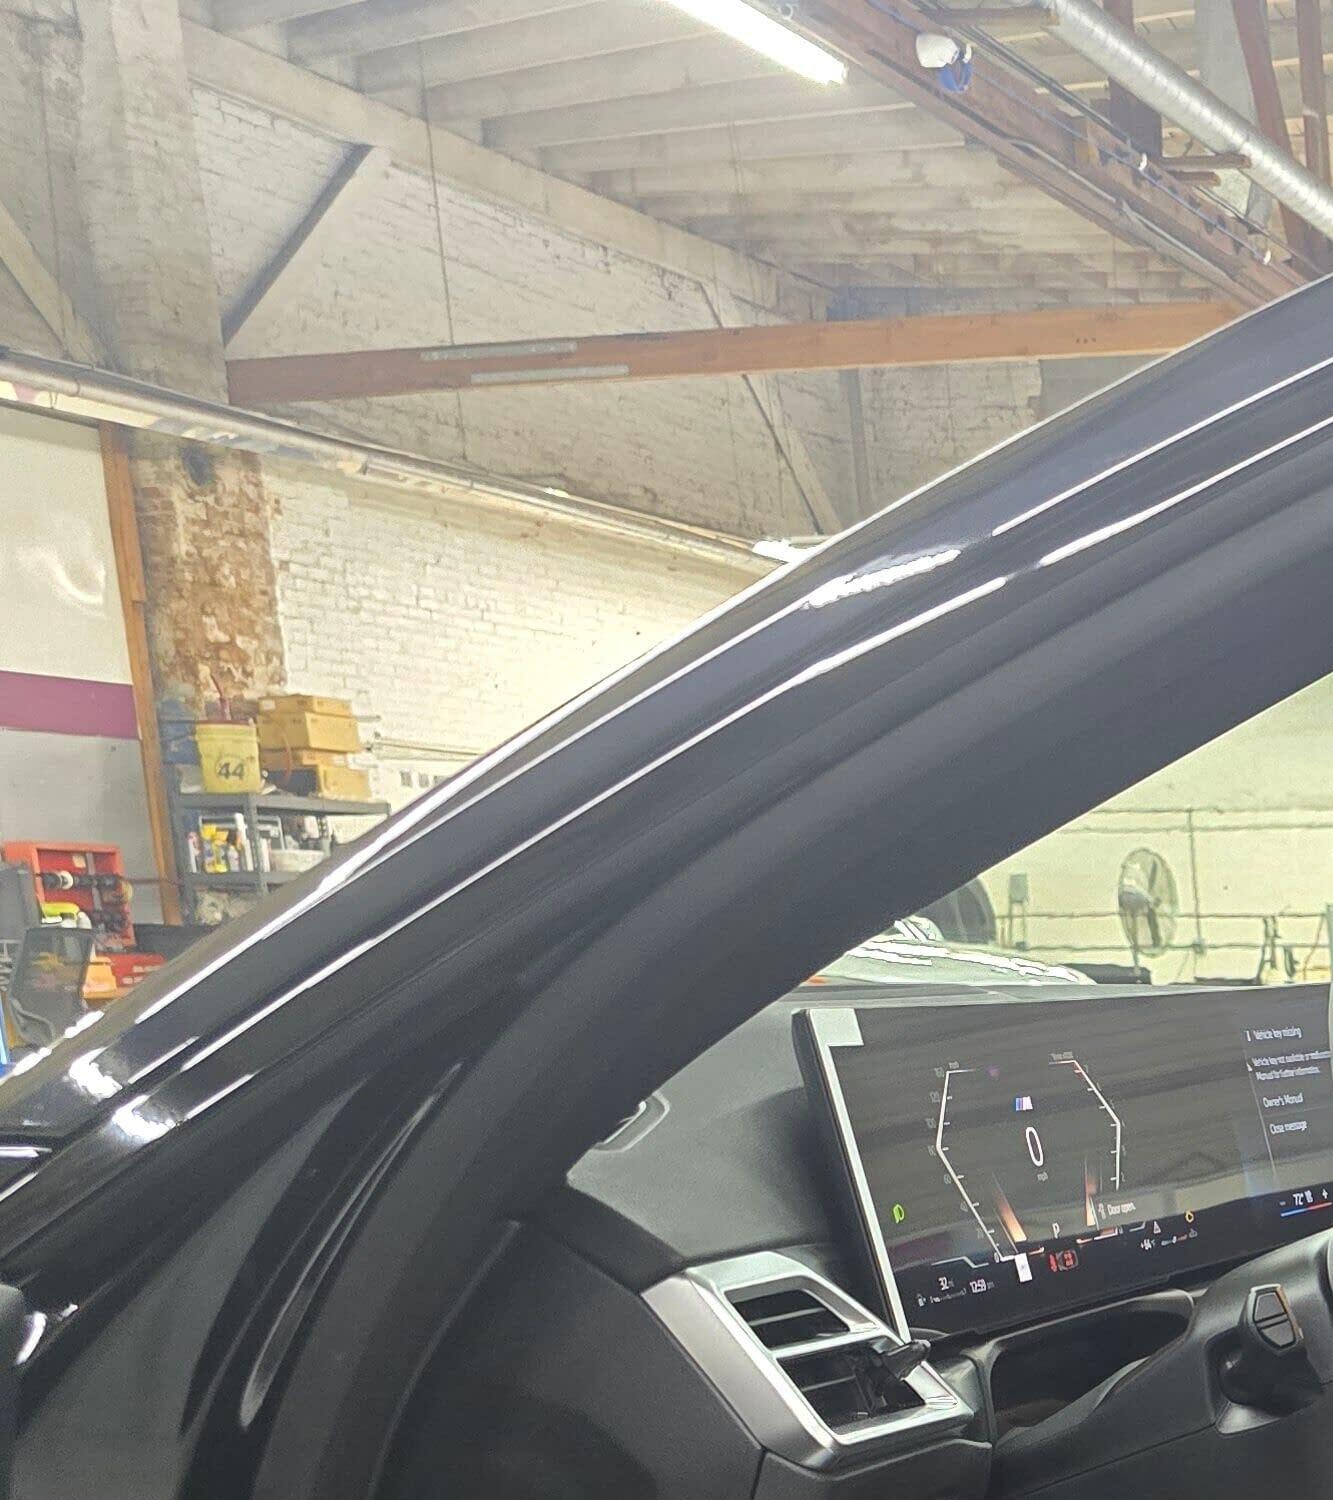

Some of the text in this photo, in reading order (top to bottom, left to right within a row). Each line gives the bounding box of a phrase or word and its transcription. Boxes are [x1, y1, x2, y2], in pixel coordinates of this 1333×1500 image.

[216, 761, 246, 780] 44
[1025, 1126, 1044, 1167] 0
[1107, 1204, 1121, 1216] Door
[1052, 1223, 1060, 1239] P
